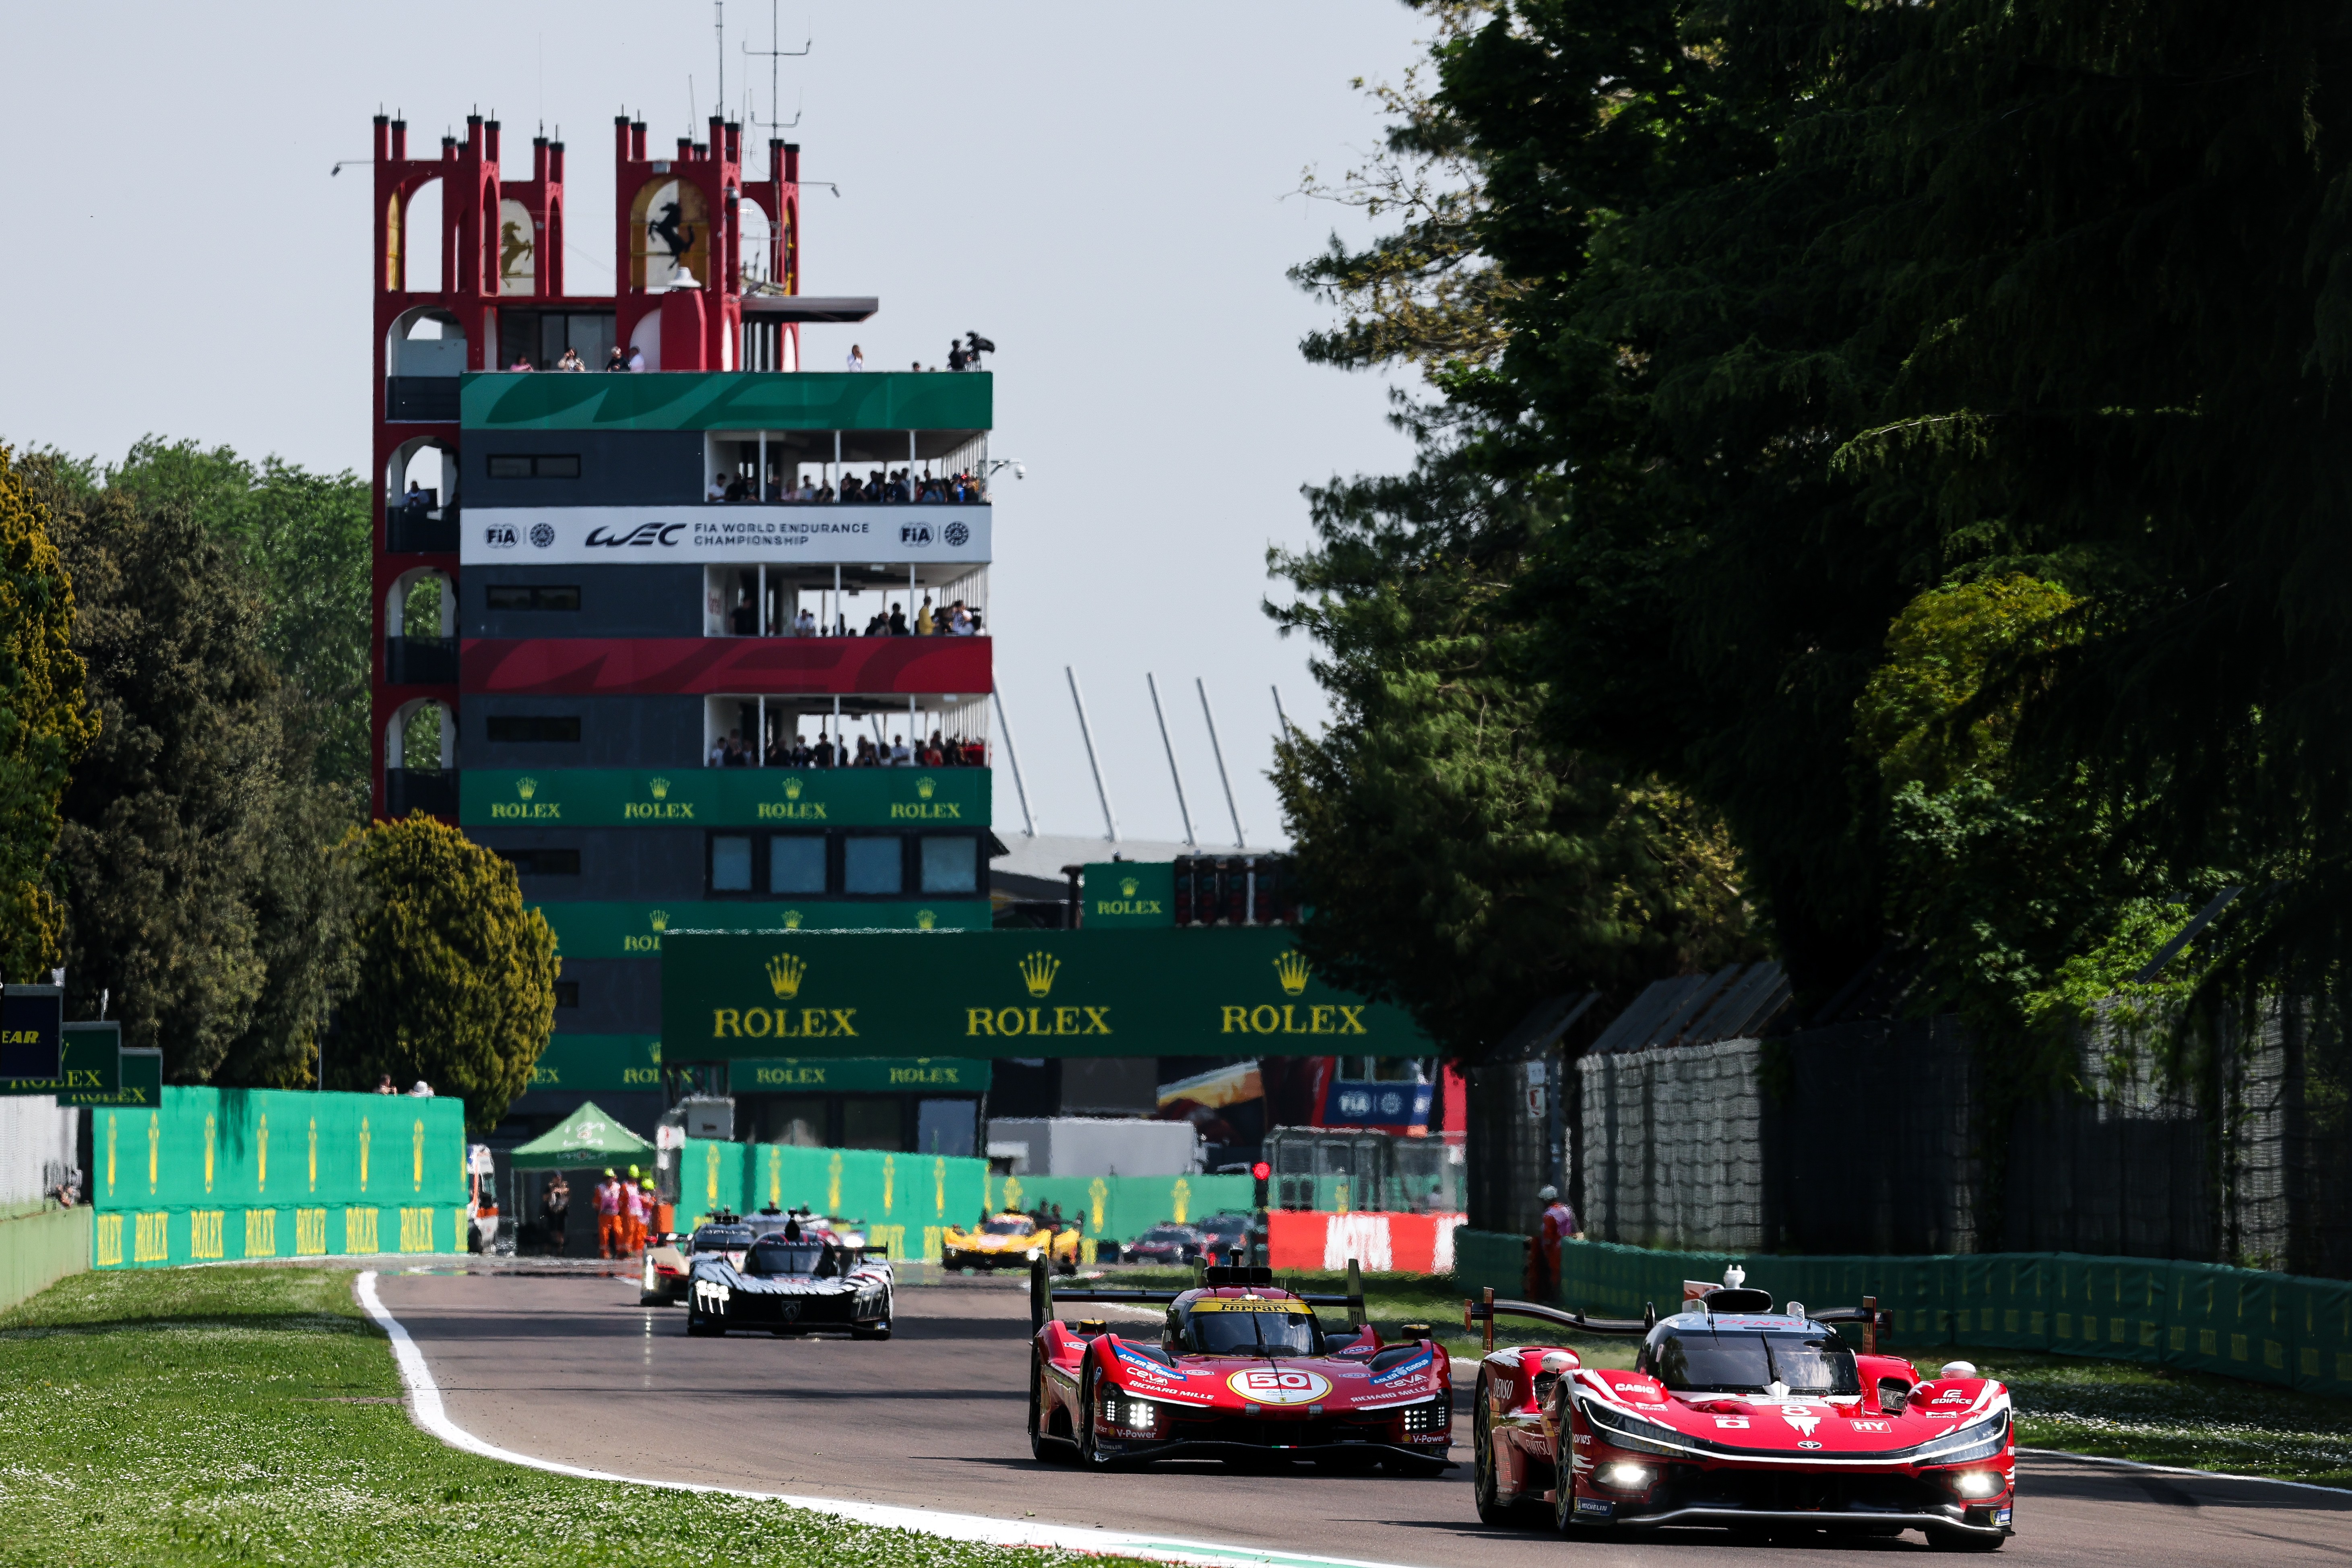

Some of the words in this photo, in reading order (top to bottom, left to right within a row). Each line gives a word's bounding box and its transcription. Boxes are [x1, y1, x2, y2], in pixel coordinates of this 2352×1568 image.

[585, 523, 687, 547] WEC
[694, 523, 717, 533] FIA
[723, 523, 775, 533] WORLD
[780, 523, 870, 533] ENDURANCE
[694, 536, 809, 546] CHAMPIONSHIP
[491, 803, 561, 818] ROLEX
[624, 803, 694, 818] ROLEX
[757, 802, 827, 819] ROLEX
[891, 803, 961, 818] ROLEX
[1097, 901, 1162, 914] ROLEX
[712, 1007, 859, 1037] ROLEX
[966, 1007, 1113, 1036] ROLEX
[1221, 1005, 1367, 1035] ROLEX
[757, 1068, 826, 1083] ROLEX
[890, 1068, 959, 1083] ROLEX
[1219, 1304, 1291, 1312] Ferrari
[1119, 1354, 1146, 1366] ADLER
[1155, 1368, 1184, 1380] GROUP
[1373, 1373, 1399, 1384] ADLER
[1406, 1359, 1429, 1371] GROUP
[1249, 1374, 1307, 1387] 50
[1129, 1380, 1178, 1394] RICHARD
[1180, 1391, 1214, 1400] MILLE
[1350, 1392, 1397, 1402] RICHARD
[1399, 1386, 1428, 1396] MILLE
[1493, 1378, 1513, 1399] DENSO
[1615, 1383, 1655, 1394] CASIO
[1781, 1405, 1812, 1416] 8
[1853, 1421, 1885, 1430] HY
[1117, 1430, 1156, 1438] V-Power
[1413, 1435, 1444, 1443] V-Power
[1526, 1439, 1551, 1457] FUJITSU
[1582, 1502, 1607, 1511] MICHELIN
